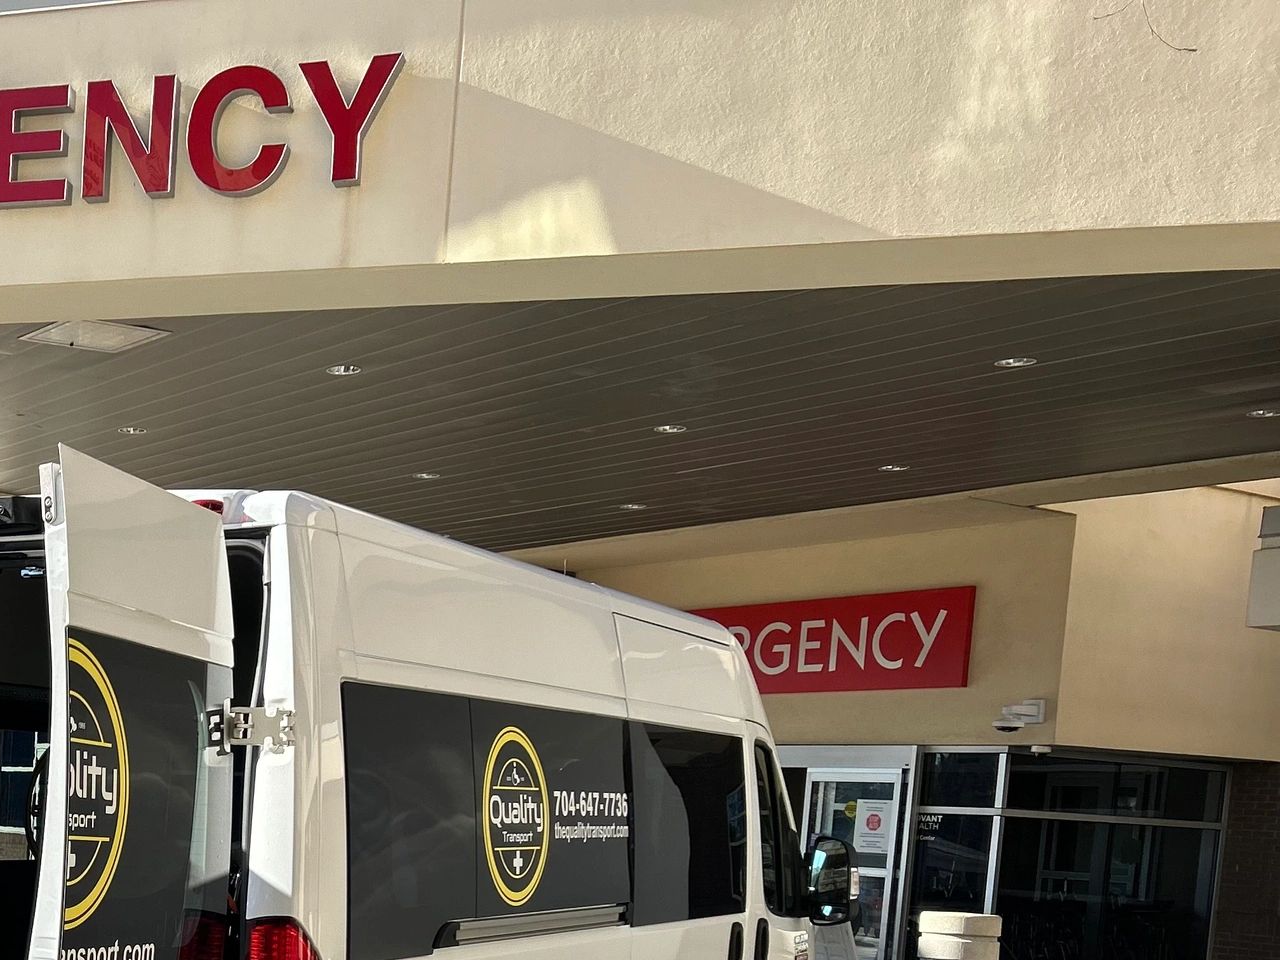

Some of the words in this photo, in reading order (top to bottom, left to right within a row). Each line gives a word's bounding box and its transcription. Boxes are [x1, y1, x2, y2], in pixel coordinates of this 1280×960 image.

[489, 794, 544, 832] Quality
[553, 791, 629, 817] 704-647-7736
[502, 831, 533, 844] Transport
[554, 822, 630, 843] thequalitytransport.com
